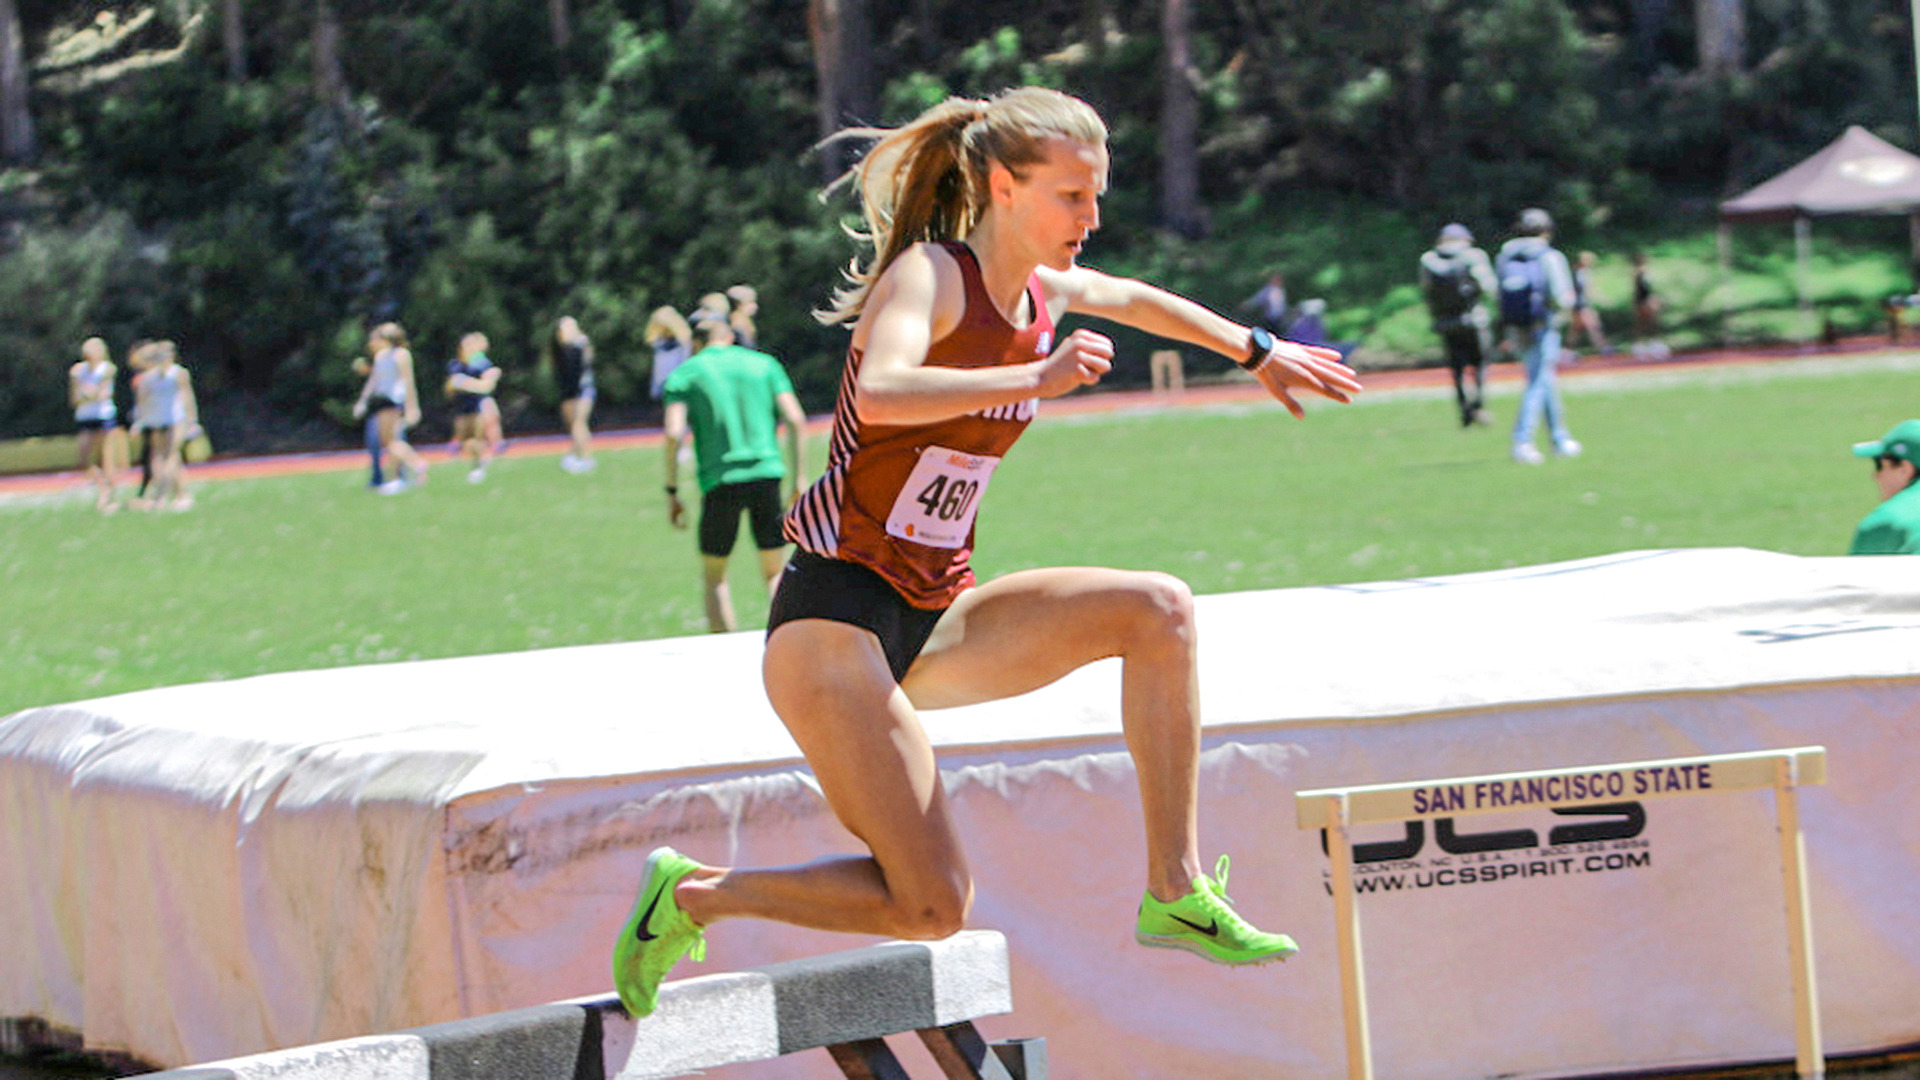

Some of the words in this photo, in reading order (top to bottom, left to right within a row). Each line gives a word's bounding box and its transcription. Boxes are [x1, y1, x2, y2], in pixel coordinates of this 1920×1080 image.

[916, 474, 979, 521] 460
[1413, 785, 1465, 814] SAN
[1475, 770, 1624, 808] FRANCISCO
[1633, 763, 1712, 794] STATE
[1324, 851, 1651, 896] WW.UCSSPIRIT.COM
